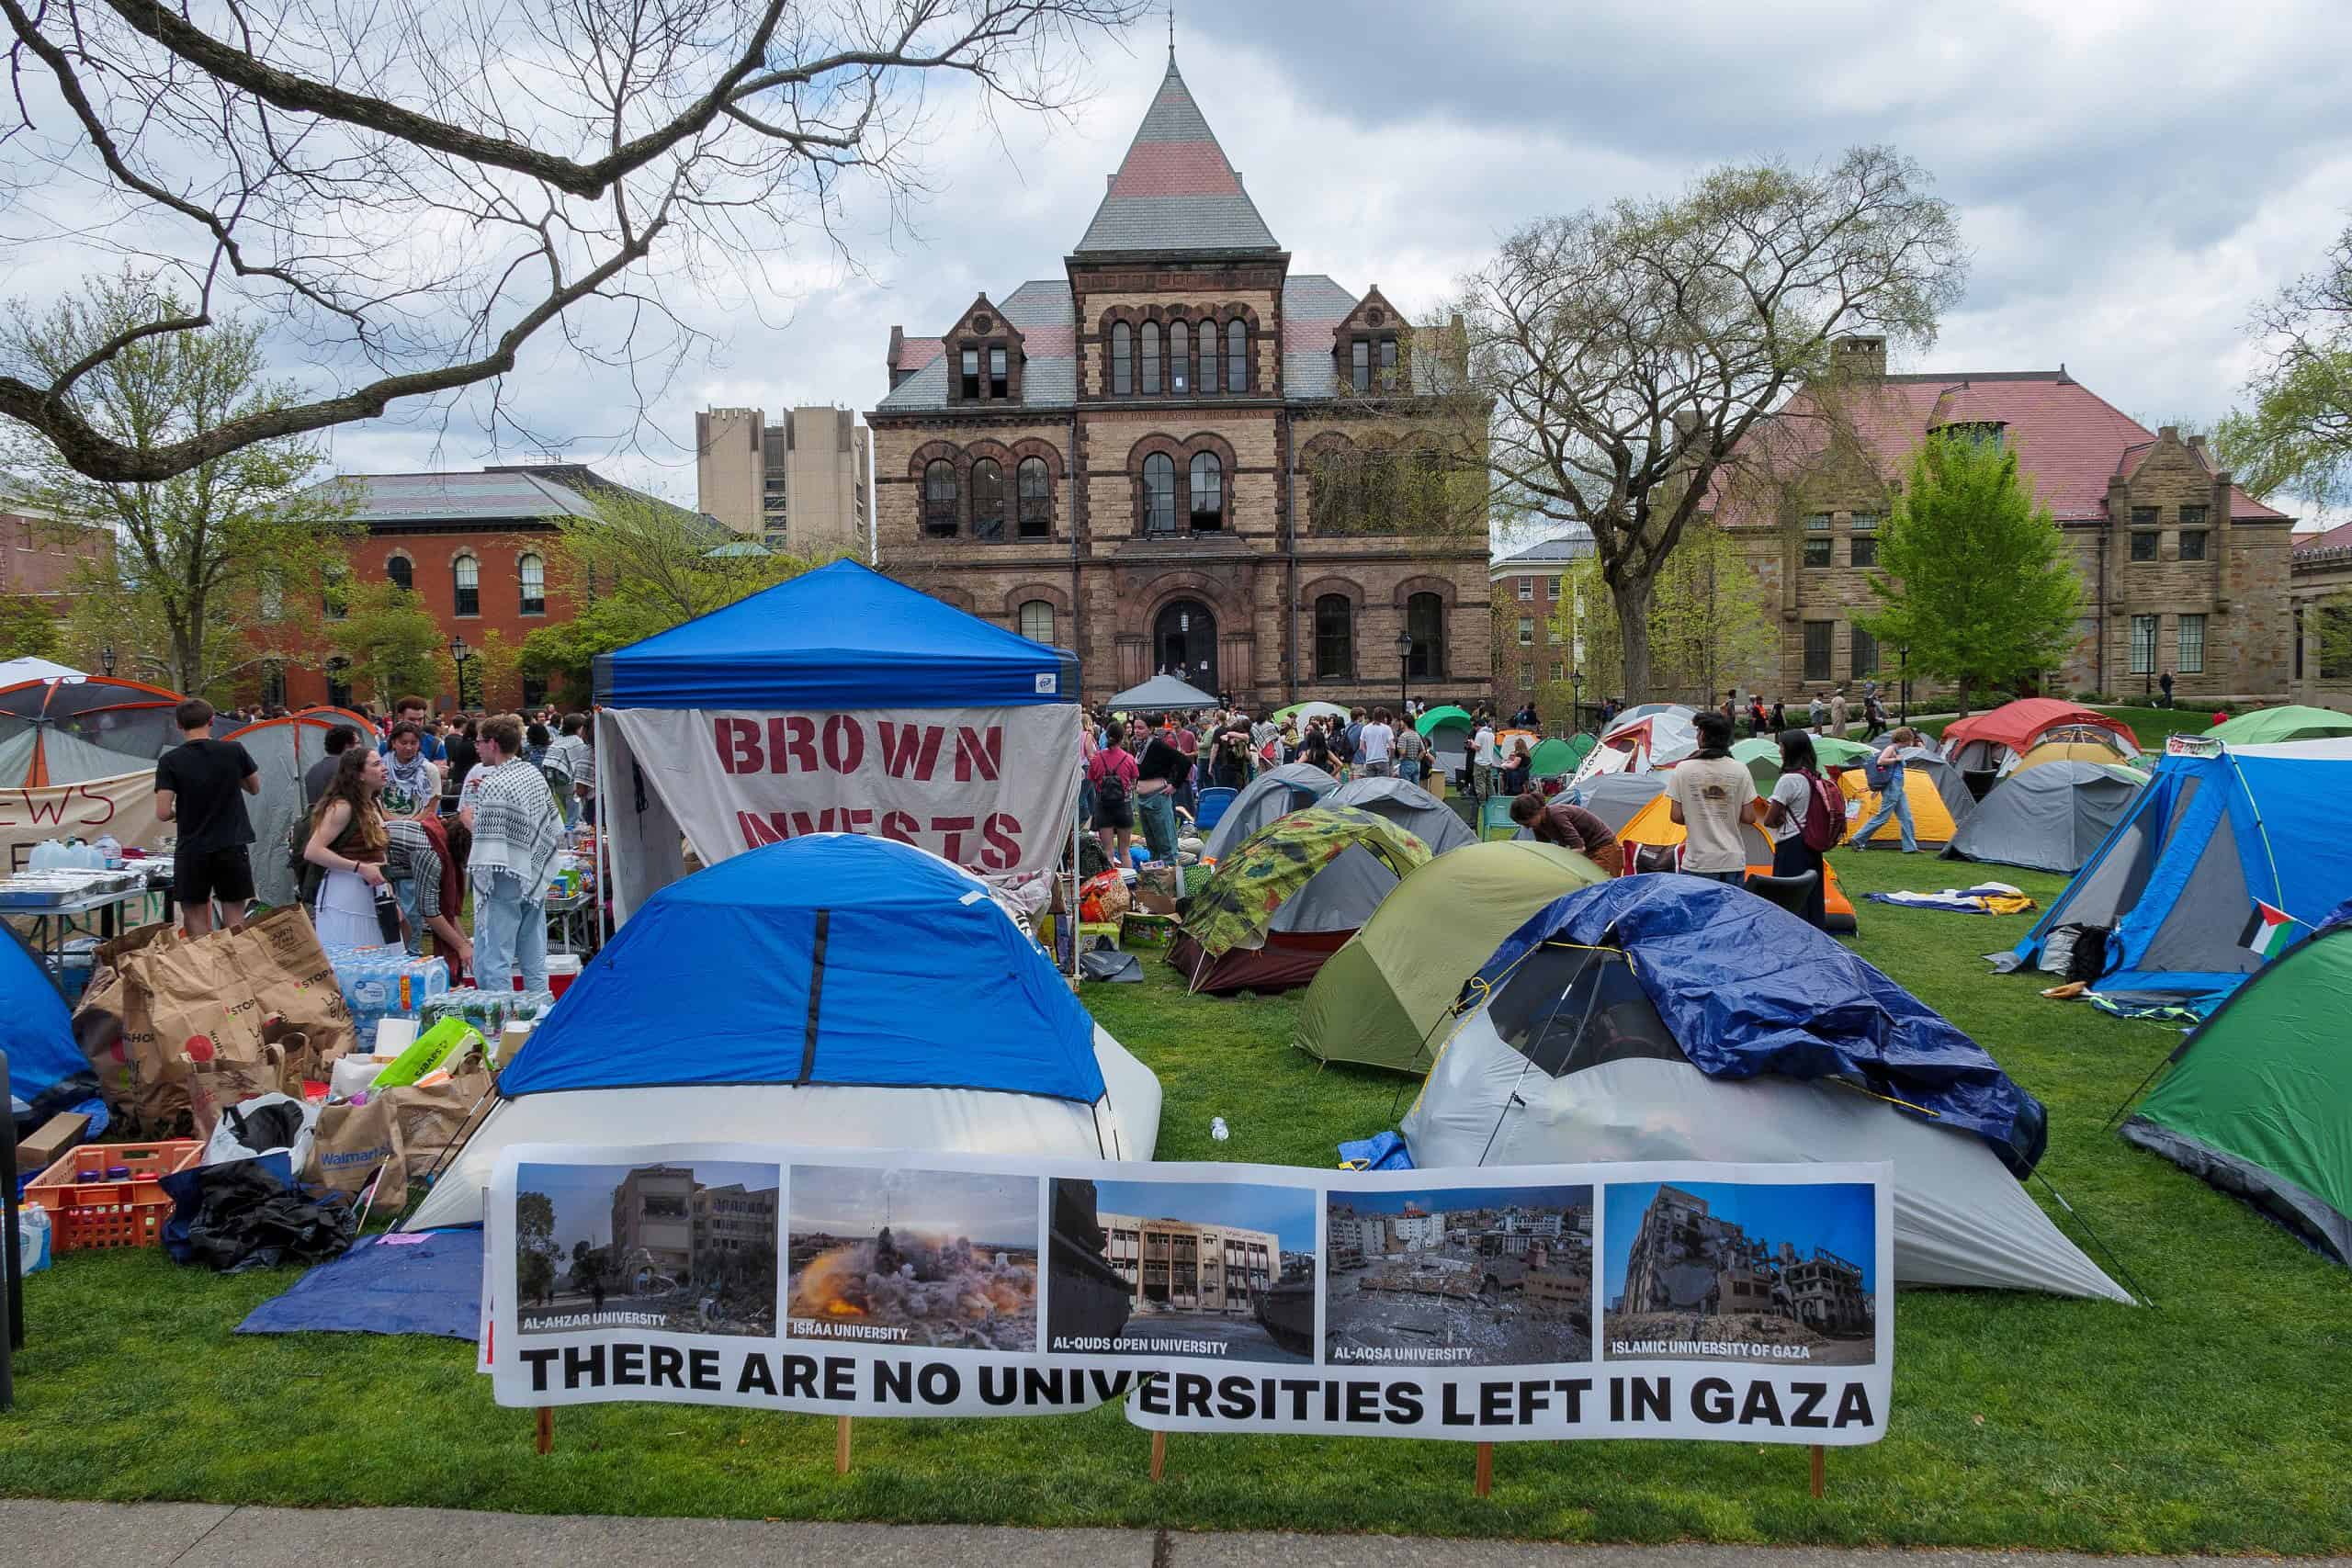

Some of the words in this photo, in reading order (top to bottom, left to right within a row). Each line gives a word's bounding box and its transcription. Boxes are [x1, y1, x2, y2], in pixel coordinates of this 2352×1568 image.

[714, 714, 1002, 782] BROWN
[523, 1313, 591, 1330] AL-AHZAR
[593, 1311, 666, 1326] UNIVERSITY
[793, 1321, 832, 1336] ISRAA
[834, 1323, 908, 1341] UNIVERSITY
[1053, 1337, 1111, 1351] AL-QUDS
[1113, 1337, 1148, 1351] OPEN
[1150, 1337, 1228, 1355] UNIVERSITY
[1333, 1347, 1392, 1360] AL-AQSA
[1395, 1347, 1474, 1360] UNIVERSITY
[1611, 1340, 1668, 1354] ISLAMIC
[1668, 1341, 1749, 1358] UNIVERSITY
[1751, 1344, 1770, 1358] OF
[1774, 1345, 1811, 1359] GAZA
[519, 1343, 722, 1392] THERE
[736, 1351, 856, 1402] ARE
[873, 1359, 961, 1405] NO
[978, 1365, 1425, 1426] UNIVERSITIES
[1442, 1378, 1593, 1426] LEFT
[1610, 1376, 1672, 1422] IN
[1690, 1376, 1875, 1428] GAZA
